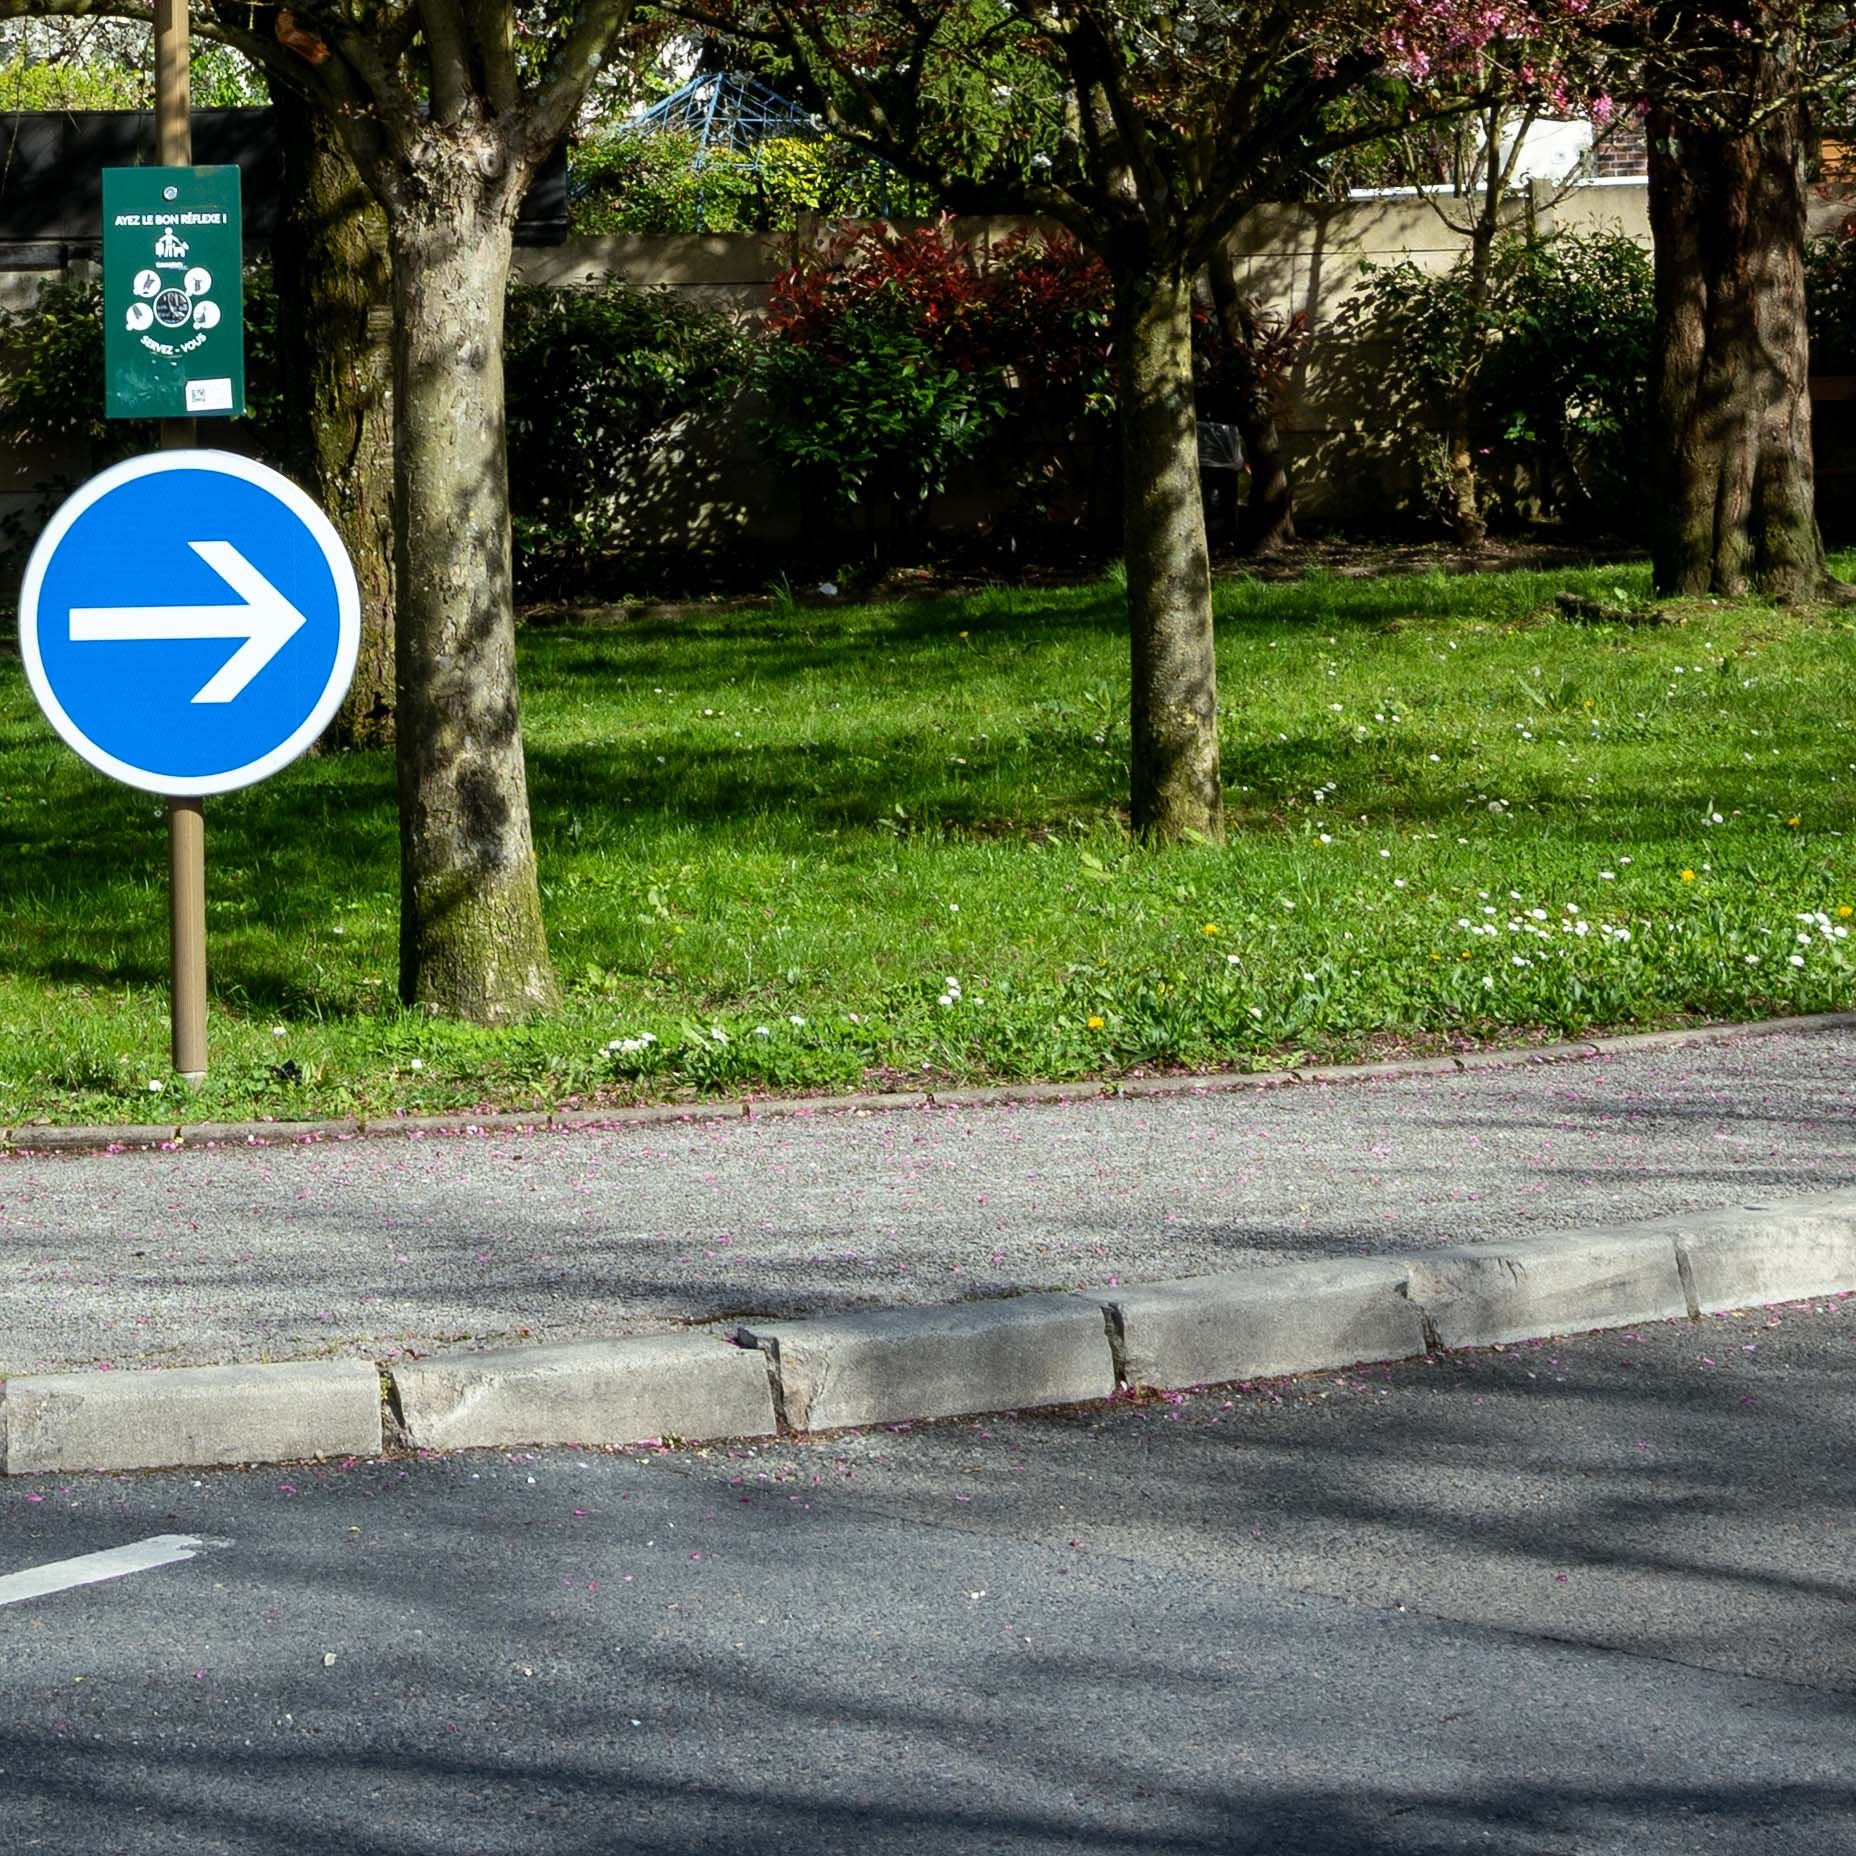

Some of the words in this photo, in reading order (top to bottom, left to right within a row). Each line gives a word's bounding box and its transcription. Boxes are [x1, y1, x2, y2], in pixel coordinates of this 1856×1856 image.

[115, 215, 140, 226] AYEZ
[142, 214, 154, 225] LE
[155, 213, 179, 225] BON
[181, 211, 221, 225] RÉFLEXE
[180, 332, 207, 353] VOUS
